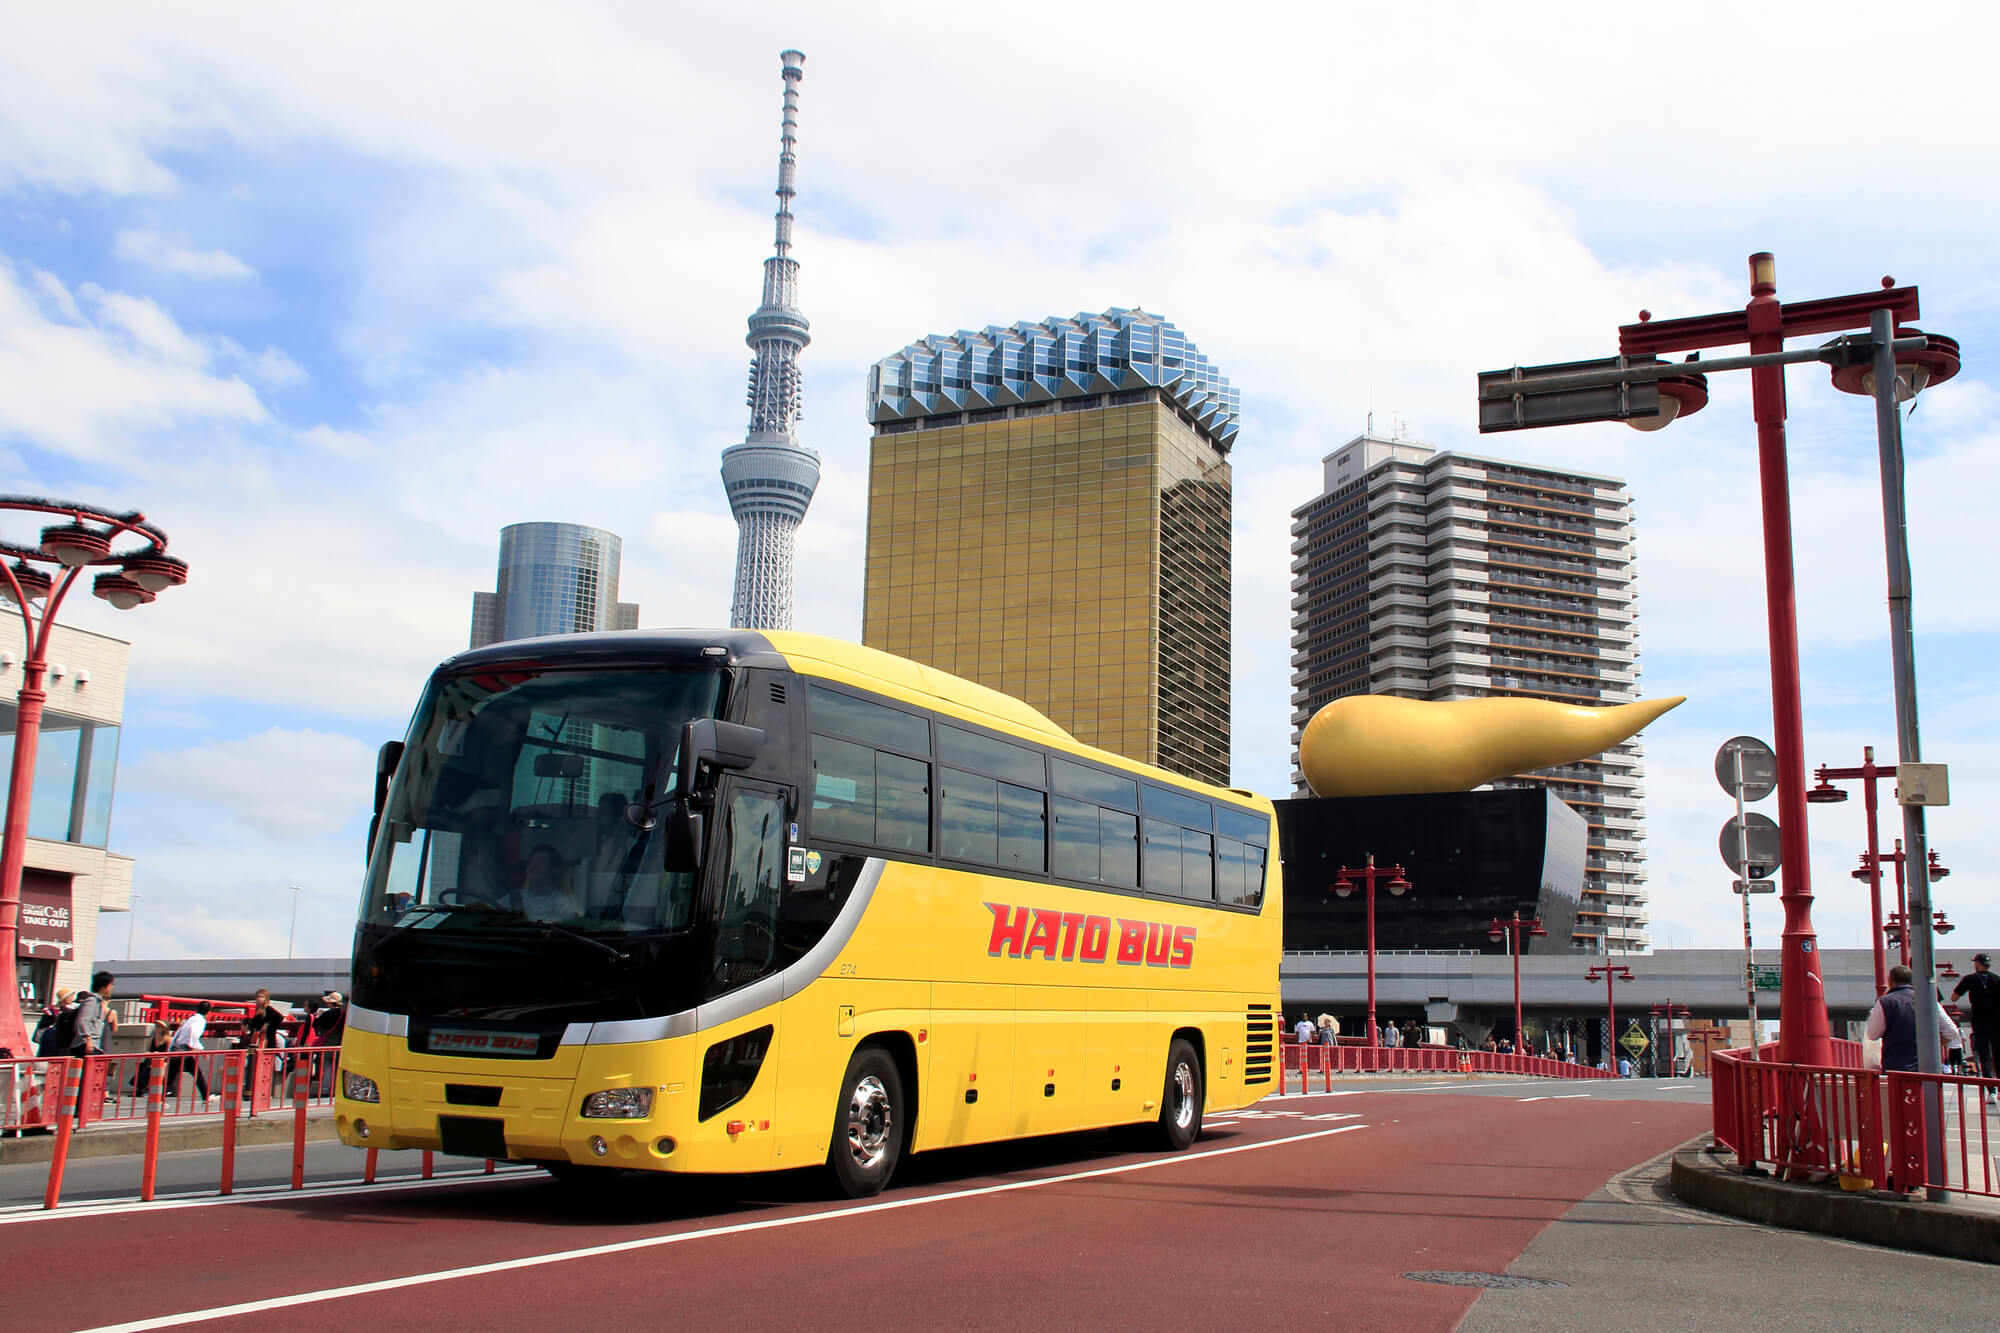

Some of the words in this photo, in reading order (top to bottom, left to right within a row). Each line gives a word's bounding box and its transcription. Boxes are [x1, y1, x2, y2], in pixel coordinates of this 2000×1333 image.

[44, 906, 69, 919] Café
[22, 915, 49, 926] TAKE
[48, 919, 70, 928] OUT
[982, 902, 1111, 964] HATO
[1116, 918, 1197, 969] BUS
[840, 963, 857, 975] 274
[433, 1033, 489, 1047] HATO
[491, 1036, 537, 1050] BUS
